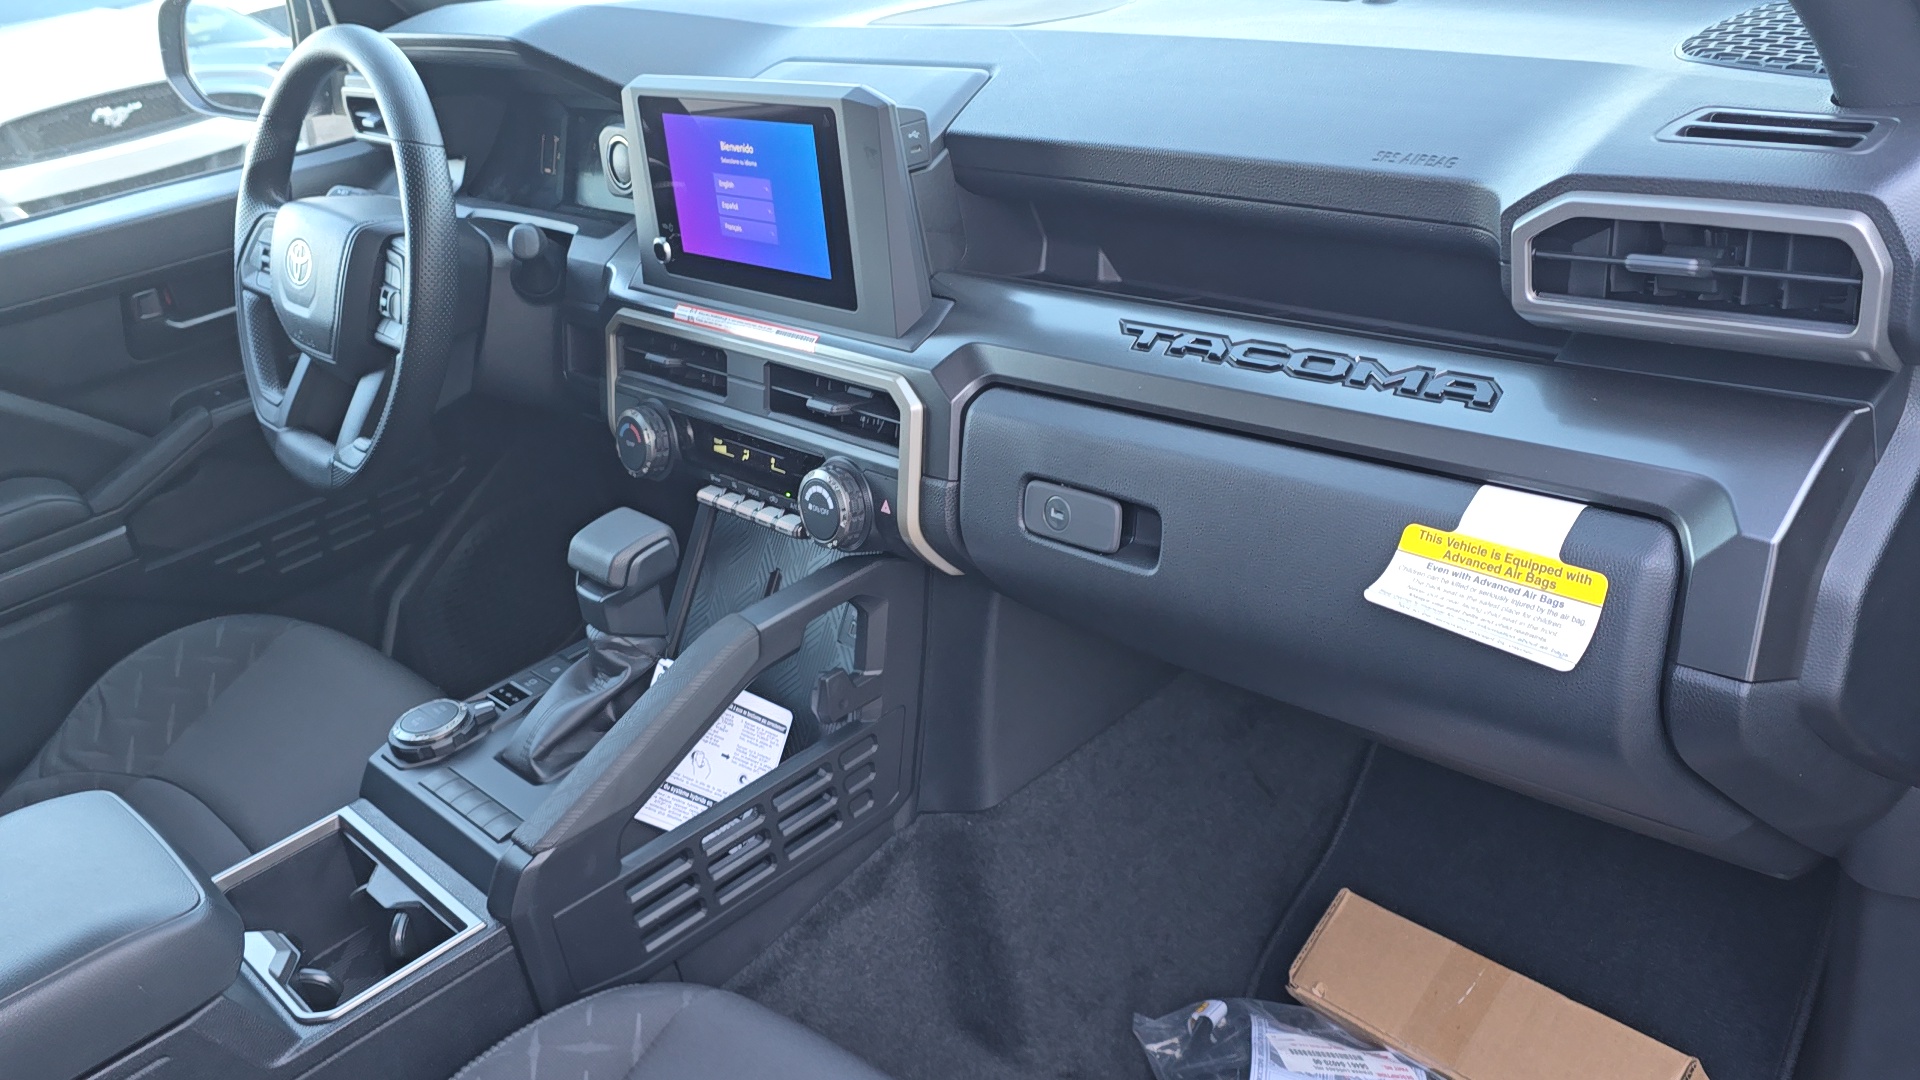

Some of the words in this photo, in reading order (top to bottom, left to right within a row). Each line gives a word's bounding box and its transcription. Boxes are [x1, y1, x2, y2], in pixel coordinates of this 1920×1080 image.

[719, 140, 755, 155] Bienvenido
[718, 179, 735, 190] English
[721, 200, 739, 211] Español
[724, 222, 743, 233] Français
[1119, 318, 1504, 413] TACOMA
[1419, 529, 1443, 545] This
[1447, 536, 1488, 558] Vehicle
[1490, 548, 1502, 561] is
[1504, 552, 1564, 578] Equipped
[1566, 570, 1593, 586] with
[1442, 549, 1503, 575] Advanced
[1504, 566, 1523, 580] Air
[1525, 571, 1557, 590] Bags
[1426, 562, 1450, 575] Even
[1451, 571, 1472, 582] with
[1473, 575, 1522, 596] Advanced
[1522, 589, 1538, 601] Air
[1539, 594, 1565, 609] Bags
[1451, 580, 1470, 592] killed
[1478, 589, 1510, 604] seriously
[1510, 598, 1536, 611] injured
[1536, 604, 1547, 615] by
[1546, 608, 1559, 618] the
[1559, 612, 1570, 621] air
